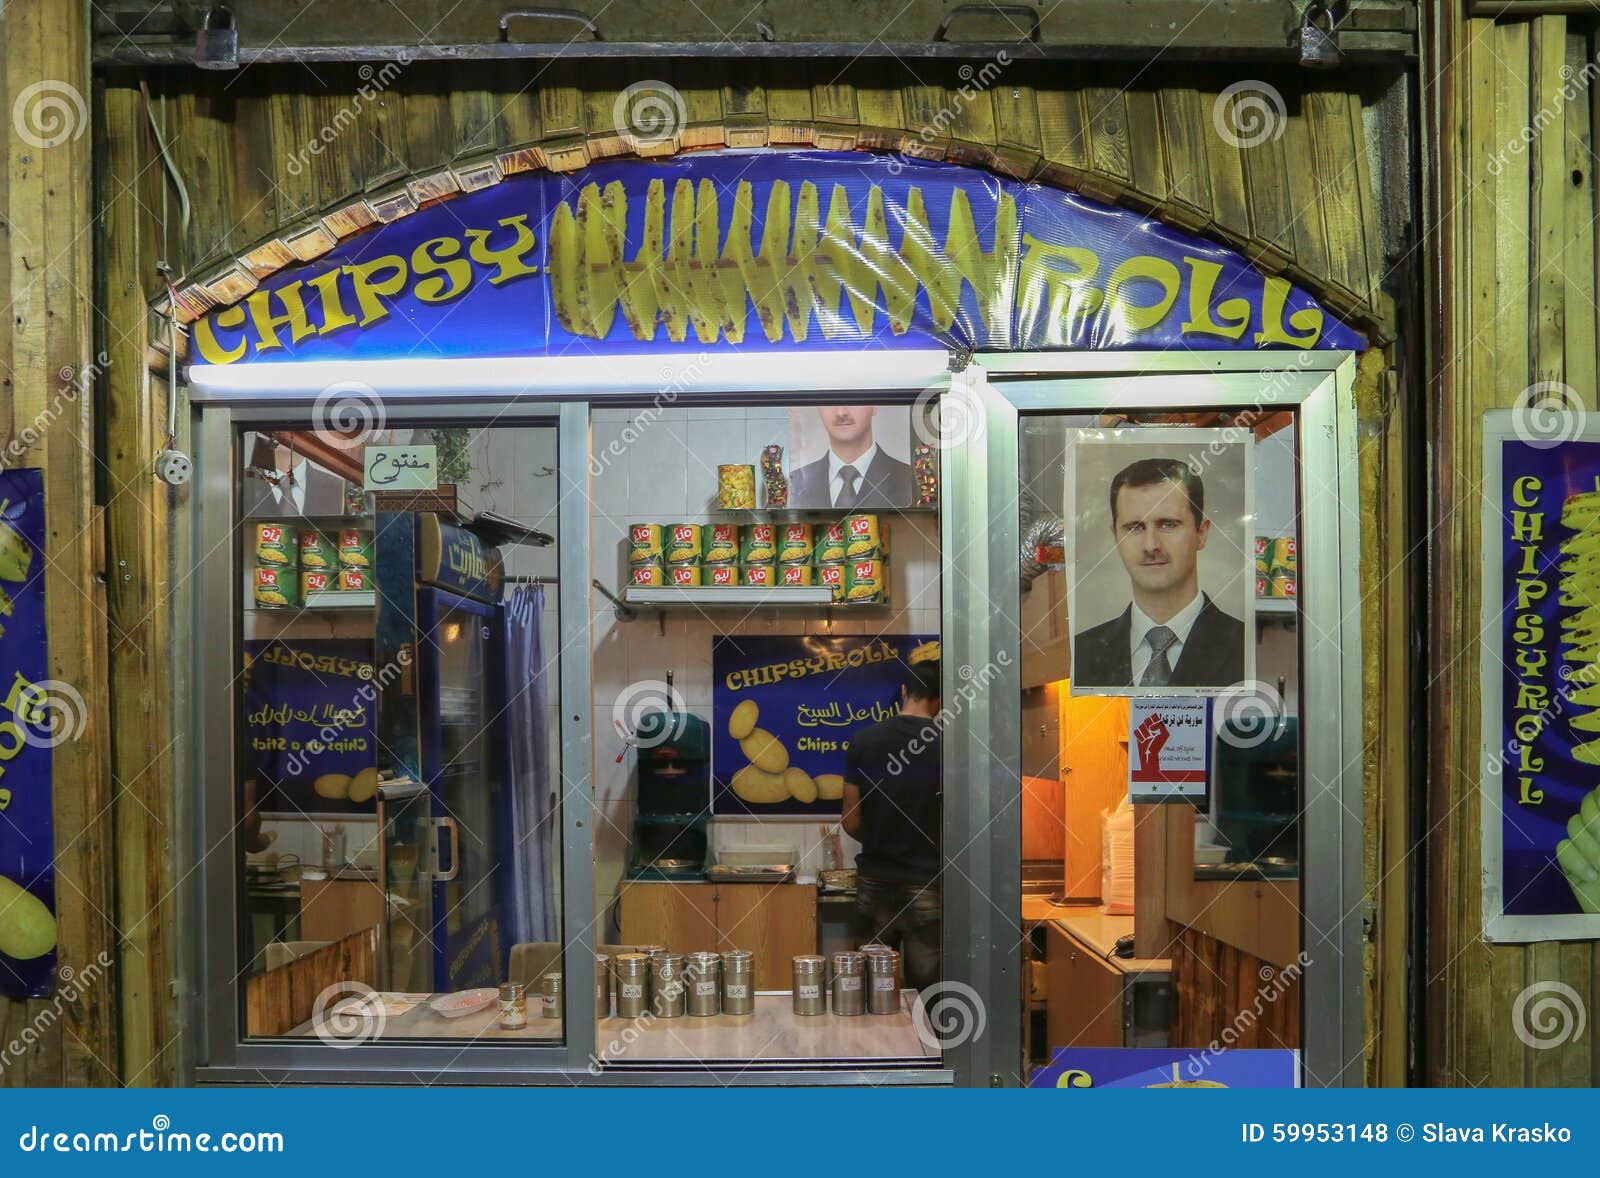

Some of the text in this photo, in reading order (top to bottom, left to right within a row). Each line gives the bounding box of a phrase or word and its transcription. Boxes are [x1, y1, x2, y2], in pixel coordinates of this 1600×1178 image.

[194, 214, 1325, 366] CHIPSY ROLL
[369, 453, 430, 484] مفتوح
[1510, 475, 1549, 804] CHIPSYROLL
[726, 641, 899, 691] CHIPSYROLL
[797, 702, 841, 727] السيخ
[797, 737, 837, 754] Chips
